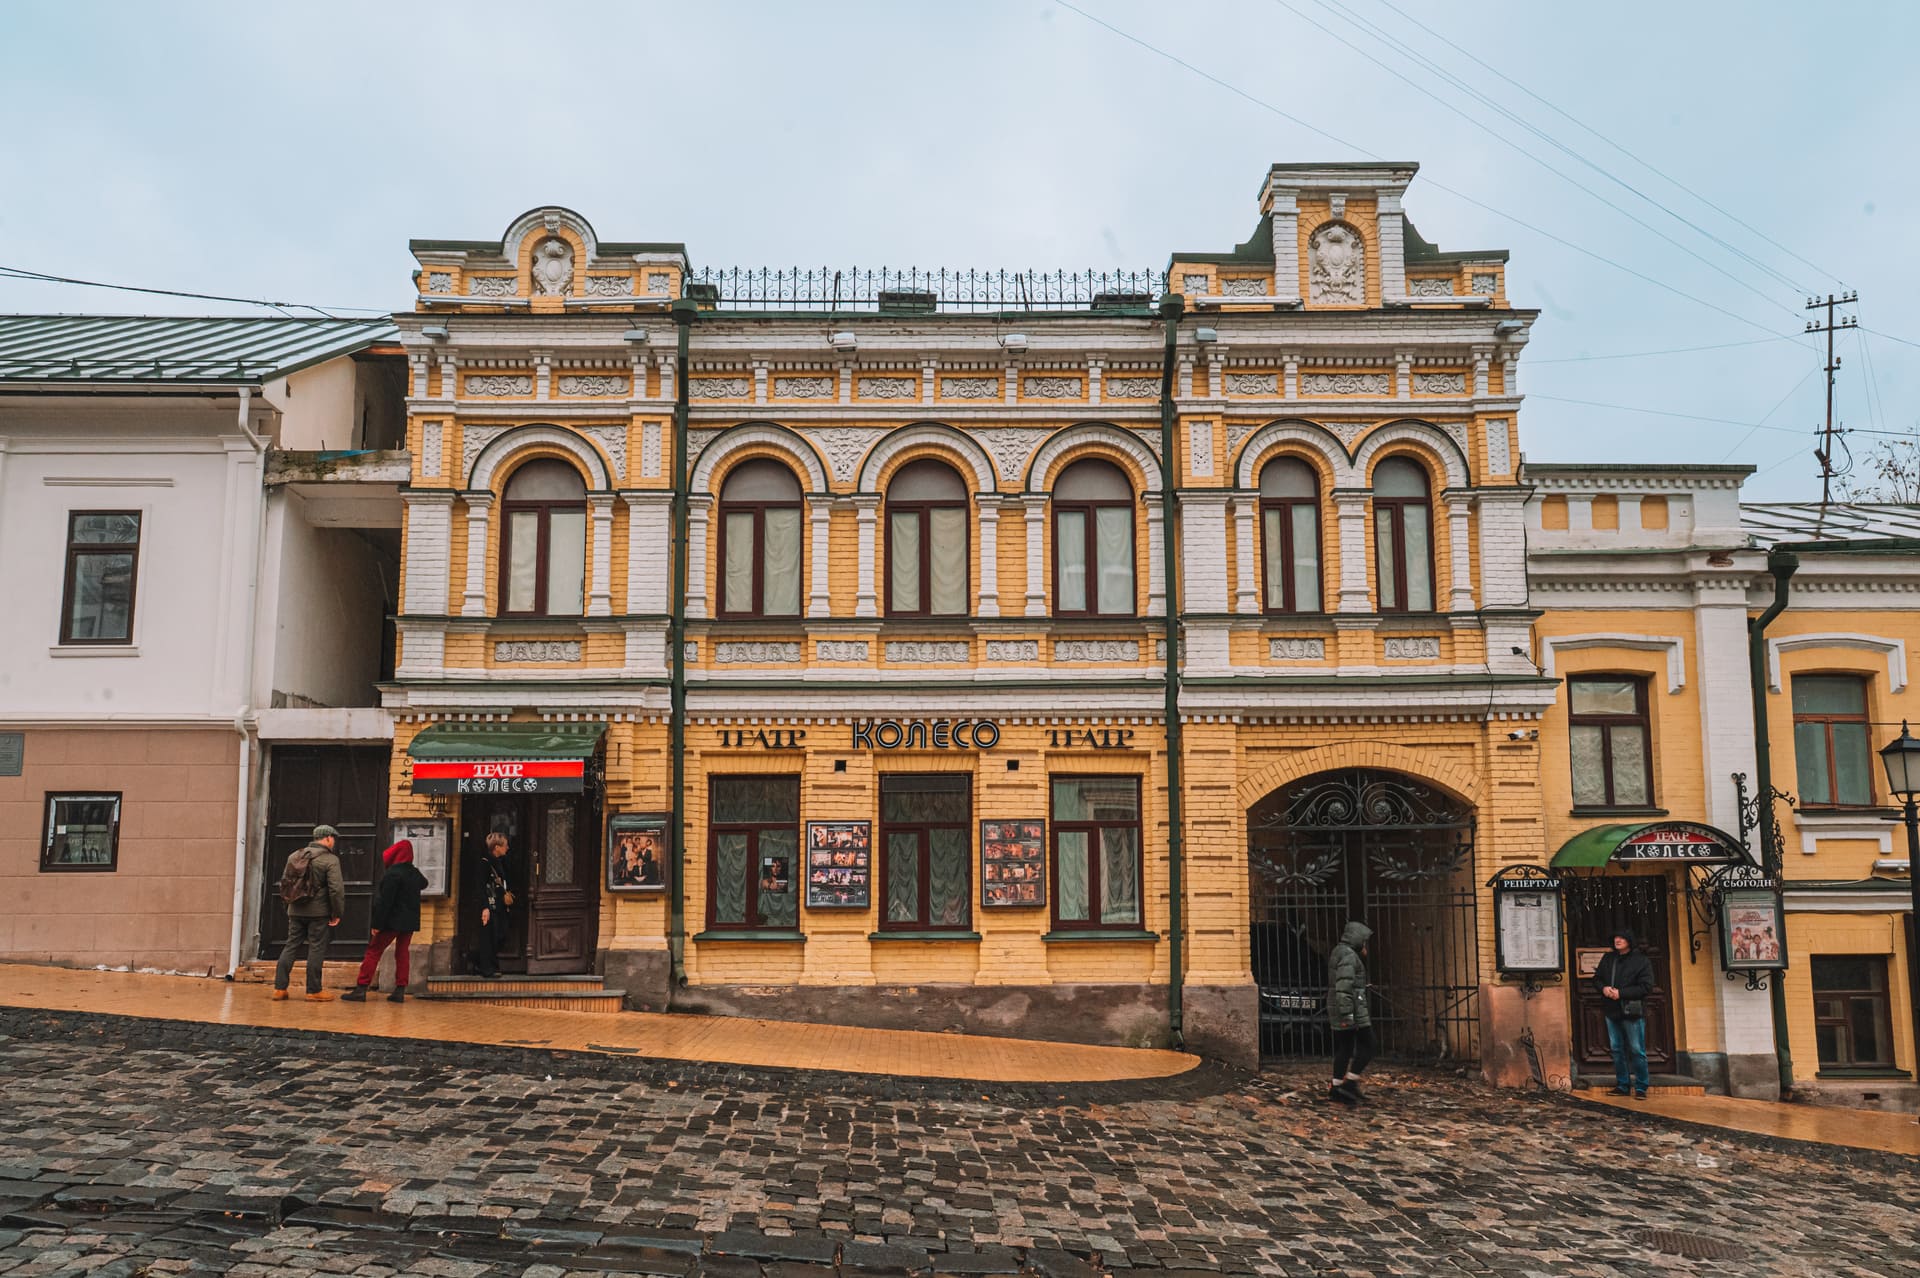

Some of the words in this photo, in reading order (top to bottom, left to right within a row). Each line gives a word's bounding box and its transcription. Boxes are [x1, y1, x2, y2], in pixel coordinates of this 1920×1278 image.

[716, 728, 806, 749] ТЕАТР
[852, 720, 1000, 749] КОЛЕСО
[1045, 728, 1135, 749] ТЕАТР
[473, 764, 524, 777] ТЕАТР
[457, 778, 538, 793] КОЛЕСО
[1654, 831, 1690, 843] ТЕАТР
[1635, 844, 1711, 858] КОЛЕСО
[1504, 879, 1560, 888] РЕПЕРТУАР
